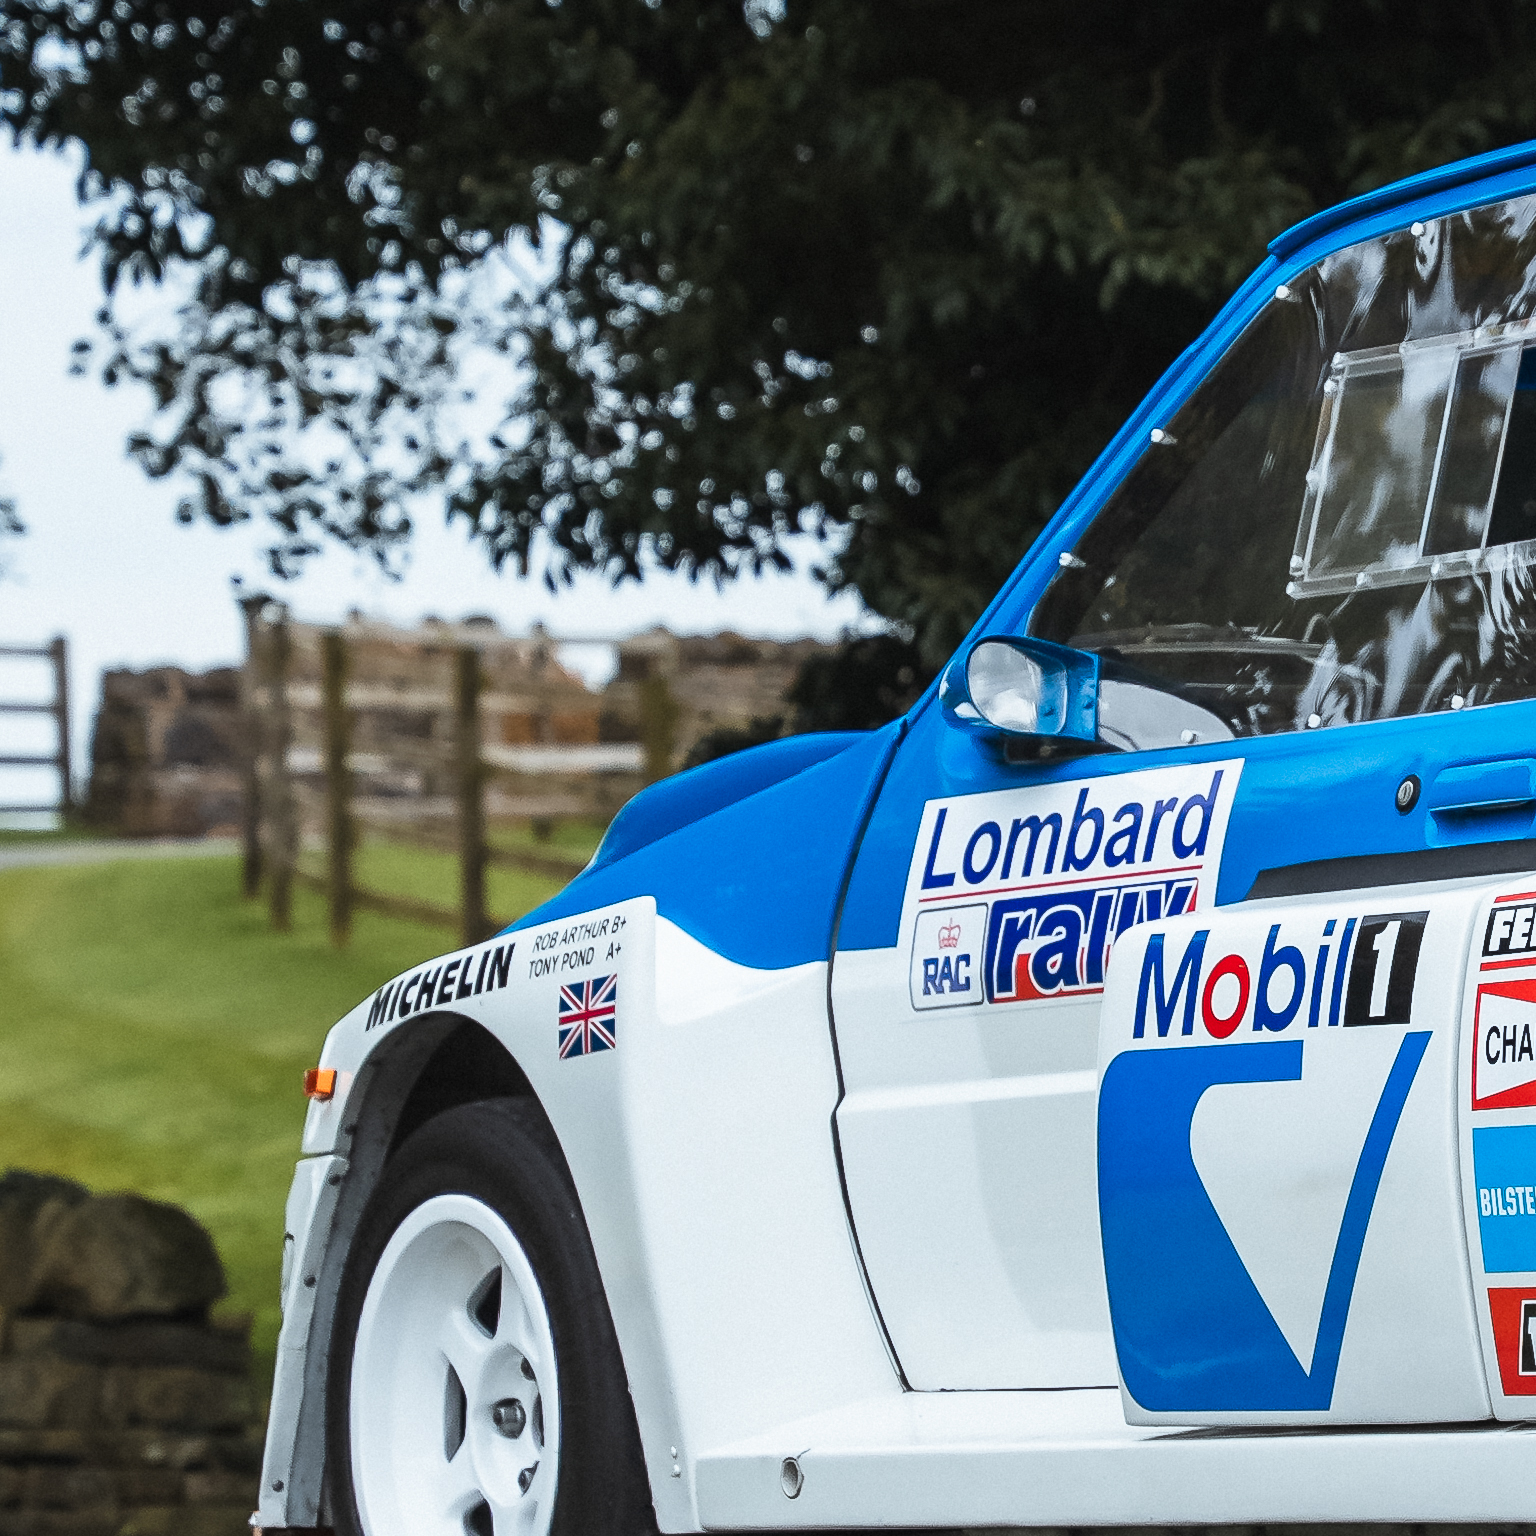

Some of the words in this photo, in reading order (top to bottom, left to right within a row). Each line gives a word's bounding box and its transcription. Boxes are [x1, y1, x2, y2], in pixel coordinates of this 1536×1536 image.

[921, 769, 1225, 892] Lombard
[529, 955, 560, 980] TONY
[561, 946, 595, 972] POND
[605, 941, 622, 961] A+
[532, 931, 559, 953] ROB
[559, 918, 610, 947] ARTHUR
[611, 915, 627, 934] B+
[365, 942, 516, 1033] MICHELIN
[922, 953, 971, 996] RAC
[1132, 917, 1358, 1040] Mobil
